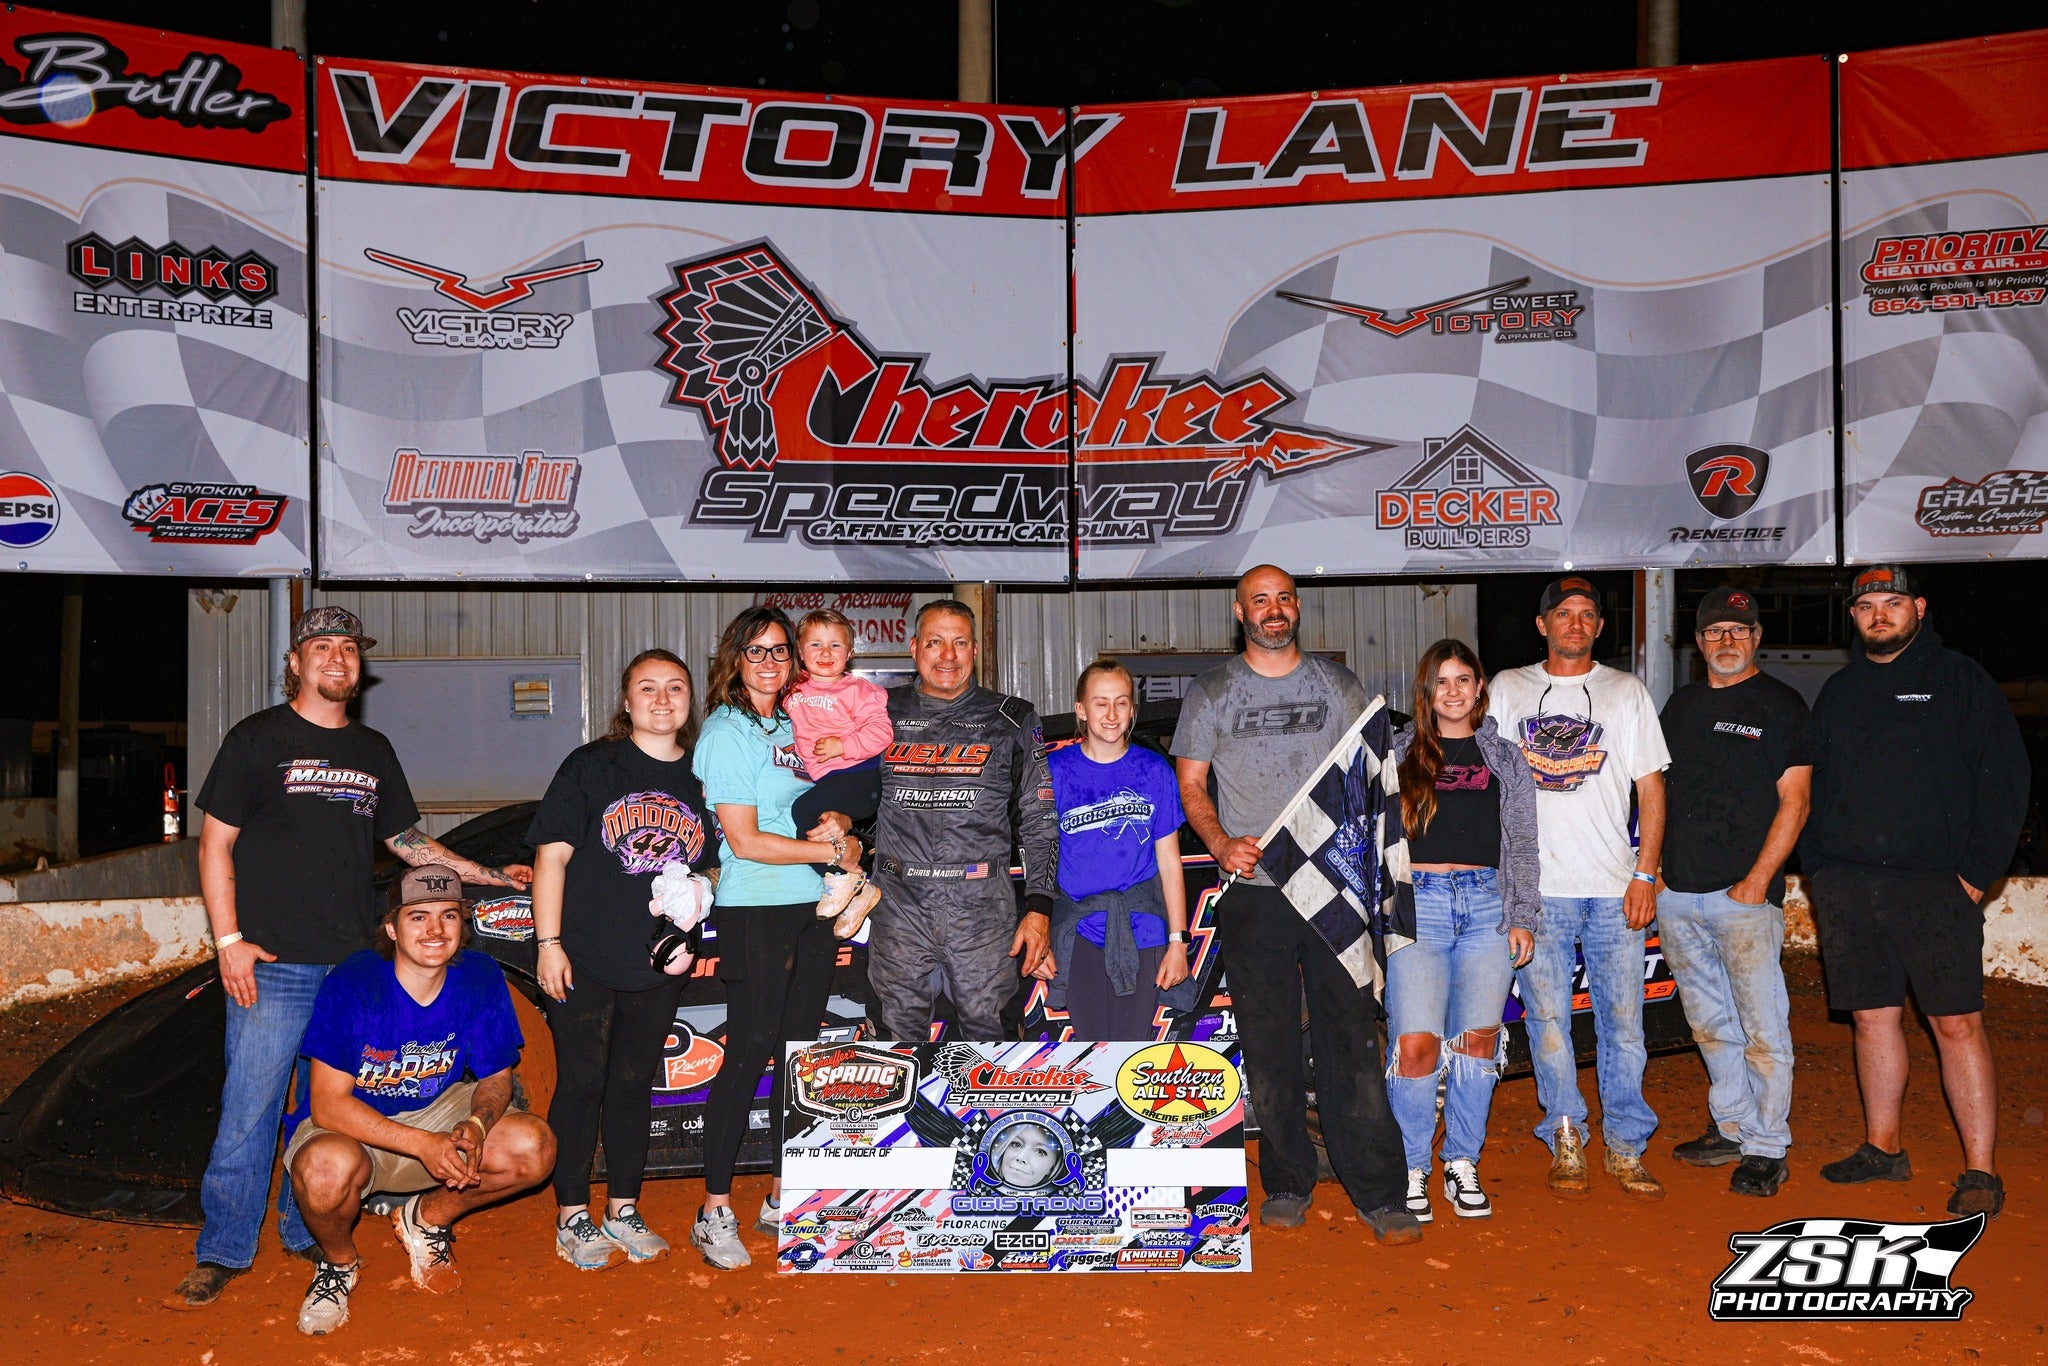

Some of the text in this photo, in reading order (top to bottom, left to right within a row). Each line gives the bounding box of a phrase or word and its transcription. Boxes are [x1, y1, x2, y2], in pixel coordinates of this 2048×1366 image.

[0, 37, 273, 118] Butler
[329, 68, 1661, 199] VICTORY LANE
[1874, 228, 2048, 265] PRIORITY
[81, 245, 268, 292] LINKS
[1873, 262, 1957, 278] HEATING
[1962, 260, 1976, 271] &
[1897, 283, 1927, 293] HVAC
[1929, 280, 1973, 292] Problem
[1975, 278, 1985, 288] is
[1988, 277, 2003, 288] My
[1493, 293, 1575, 311] SWEET
[1872, 288, 2046, 314] 864-591-1847
[74, 292, 273, 329] ENTERPRIZE
[399, 310, 573, 338] VICTORY
[449, 335, 524, 346] SEATS
[1498, 329, 1575, 342] APPAREL CO.
[775, 327, 1288, 450] Cherokee
[387, 453, 573, 504] MECHANICAL EDGE
[169, 483, 254, 497] SMOKIN'
[0, 502, 54, 519] EPSI
[145, 496, 279, 526] ACES
[704, 472, 1243, 537] Speedway
[1379, 488, 1560, 528] DECKER
[408, 506, 577, 541] Incorporated
[1920, 507, 2048, 525] Custom Graphics
[156, 525, 255, 533] PERFORMANCE
[929, 522, 1012, 545] SOUTH
[1013, 520, 1148, 544] CAROLINA
[1407, 526, 1530, 549] BUILDERS
[1667, 526, 1787, 544] RENEGADE
[1931, 524, 2041, 534] 704.434.7572
[1238, 704, 1320, 731] HST
[1713, 720, 1737, 732] BUZZE
[1736, 724, 1763, 738] RACING
[884, 742, 992, 766] WELLS
[1522, 749, 1606, 776] ADDEN
[287, 768, 379, 790] MADDEN
[892, 765, 984, 775] MOTORSPORTS
[894, 787, 980, 801] HENDERSON
[1062, 803, 1152, 831] #GIGISTRONG
[603, 798, 705, 863] MADDEN
[632, 832, 677, 858] 44
[906, 867, 965, 879] CHRIS MADDEN
[488, 908, 534, 924] SPRIN
[670, 1051, 718, 1081] Racing
[967, 1061, 1090, 1089] Cherokee
[1132, 1061, 1224, 1086] Southern
[812, 1064, 898, 1088] SPRING
[817, 1082, 891, 1100] NATIONALS
[947, 1091, 1076, 1106] Speedway
[1133, 1086, 1225, 1100] ALL STAR
[1141, 1107, 1218, 1122] RACING SERIES
[784, 1148, 893, 1158] PAY TO THE ORDER OF
[817, 1208, 859, 1216] COLLINS
[952, 1195, 1104, 1212] GIGISTRONG
[1200, 1203, 1245, 1218] AMERICAN
[785, 1225, 828, 1234] SUNOCO
[943, 1220, 1007, 1229] FLORACING
[995, 1234, 1048, 1248] EZGO
[1055, 1236, 1095, 1245] DIRT
[958, 1248, 984, 1269] VP
[1120, 1250, 1179, 1262] KNOWLES
